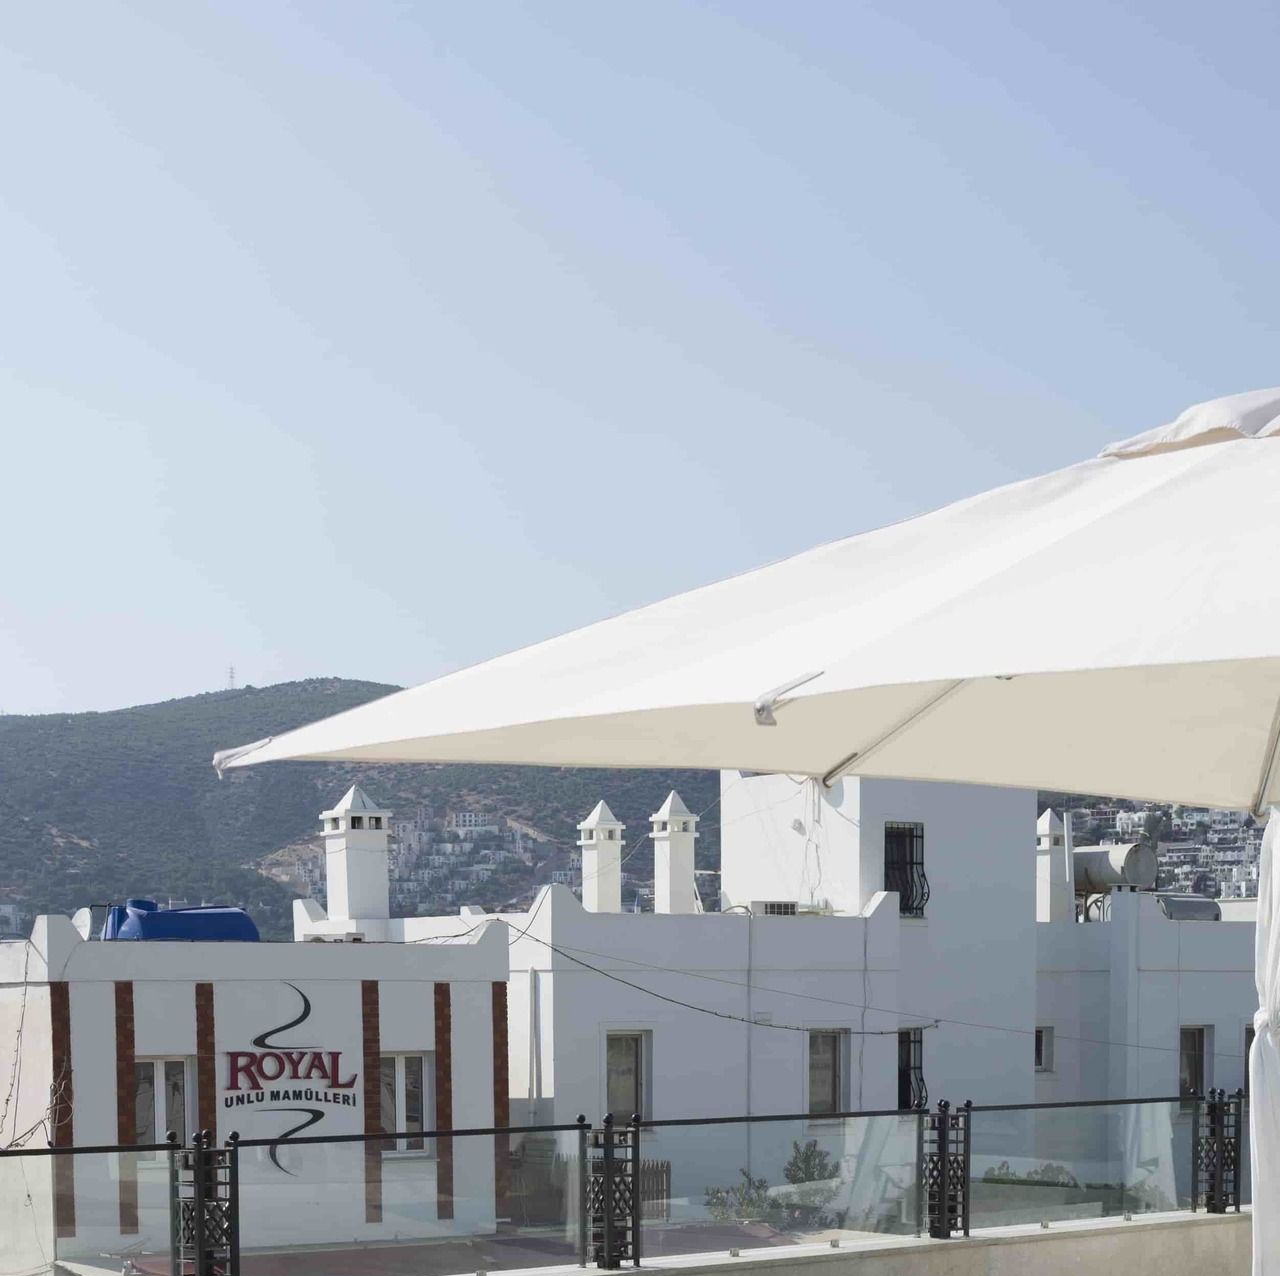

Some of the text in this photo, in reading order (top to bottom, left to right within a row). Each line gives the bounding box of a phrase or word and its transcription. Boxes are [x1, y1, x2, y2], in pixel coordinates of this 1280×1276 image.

[226, 1052, 358, 1090] ROYAL
[224, 1088, 356, 1108] UNLU MAMÜLLERİ
